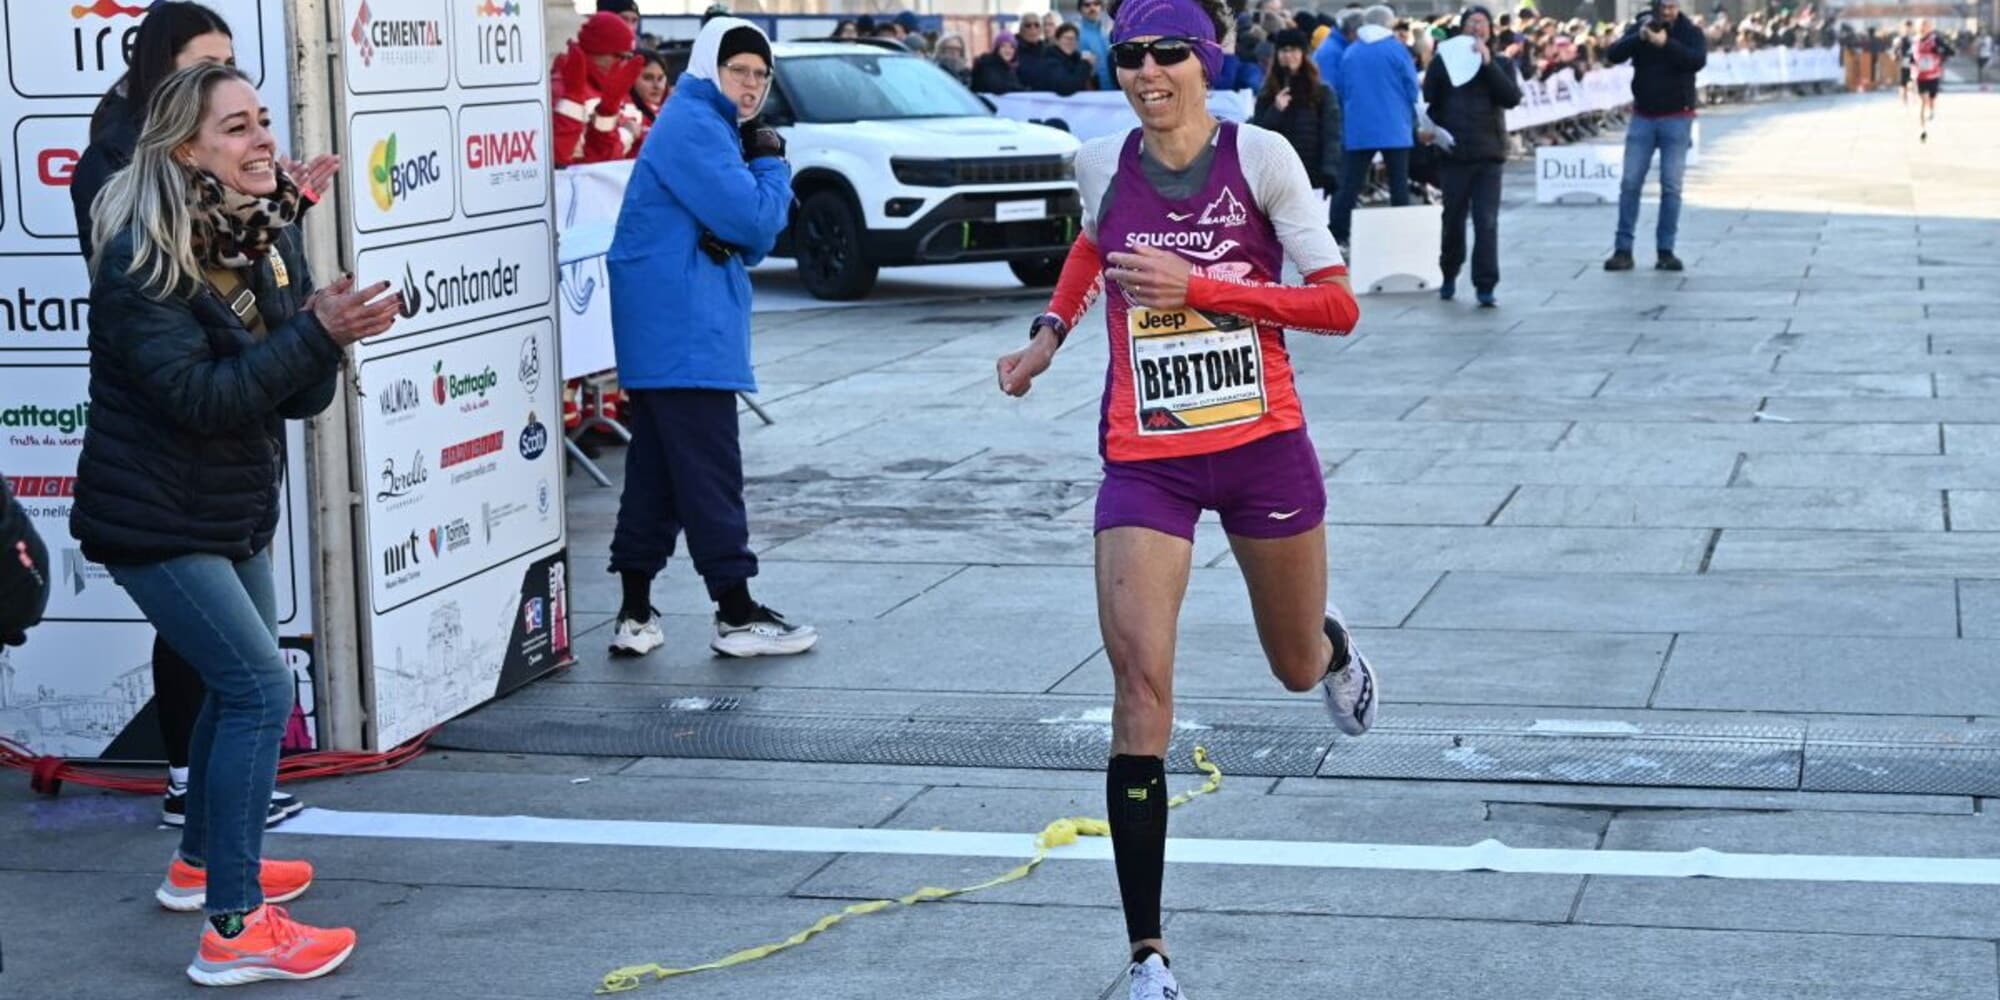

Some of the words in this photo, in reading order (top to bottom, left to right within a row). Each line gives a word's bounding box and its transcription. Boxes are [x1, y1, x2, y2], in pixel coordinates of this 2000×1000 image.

[74, 26, 141, 72] ire
[371, 20, 442, 48] CEMENTAL
[478, 24, 523, 64] iren
[466, 130, 537, 170] GIMAX
[1542, 158, 1619, 180] DuLac
[1125, 230, 1215, 250] saucony
[424, 256, 520, 314] Santander
[1138, 311, 1187, 329] Jeep
[449, 364, 498, 399] Battaglio
[1139, 345, 1256, 401] BERTONE
